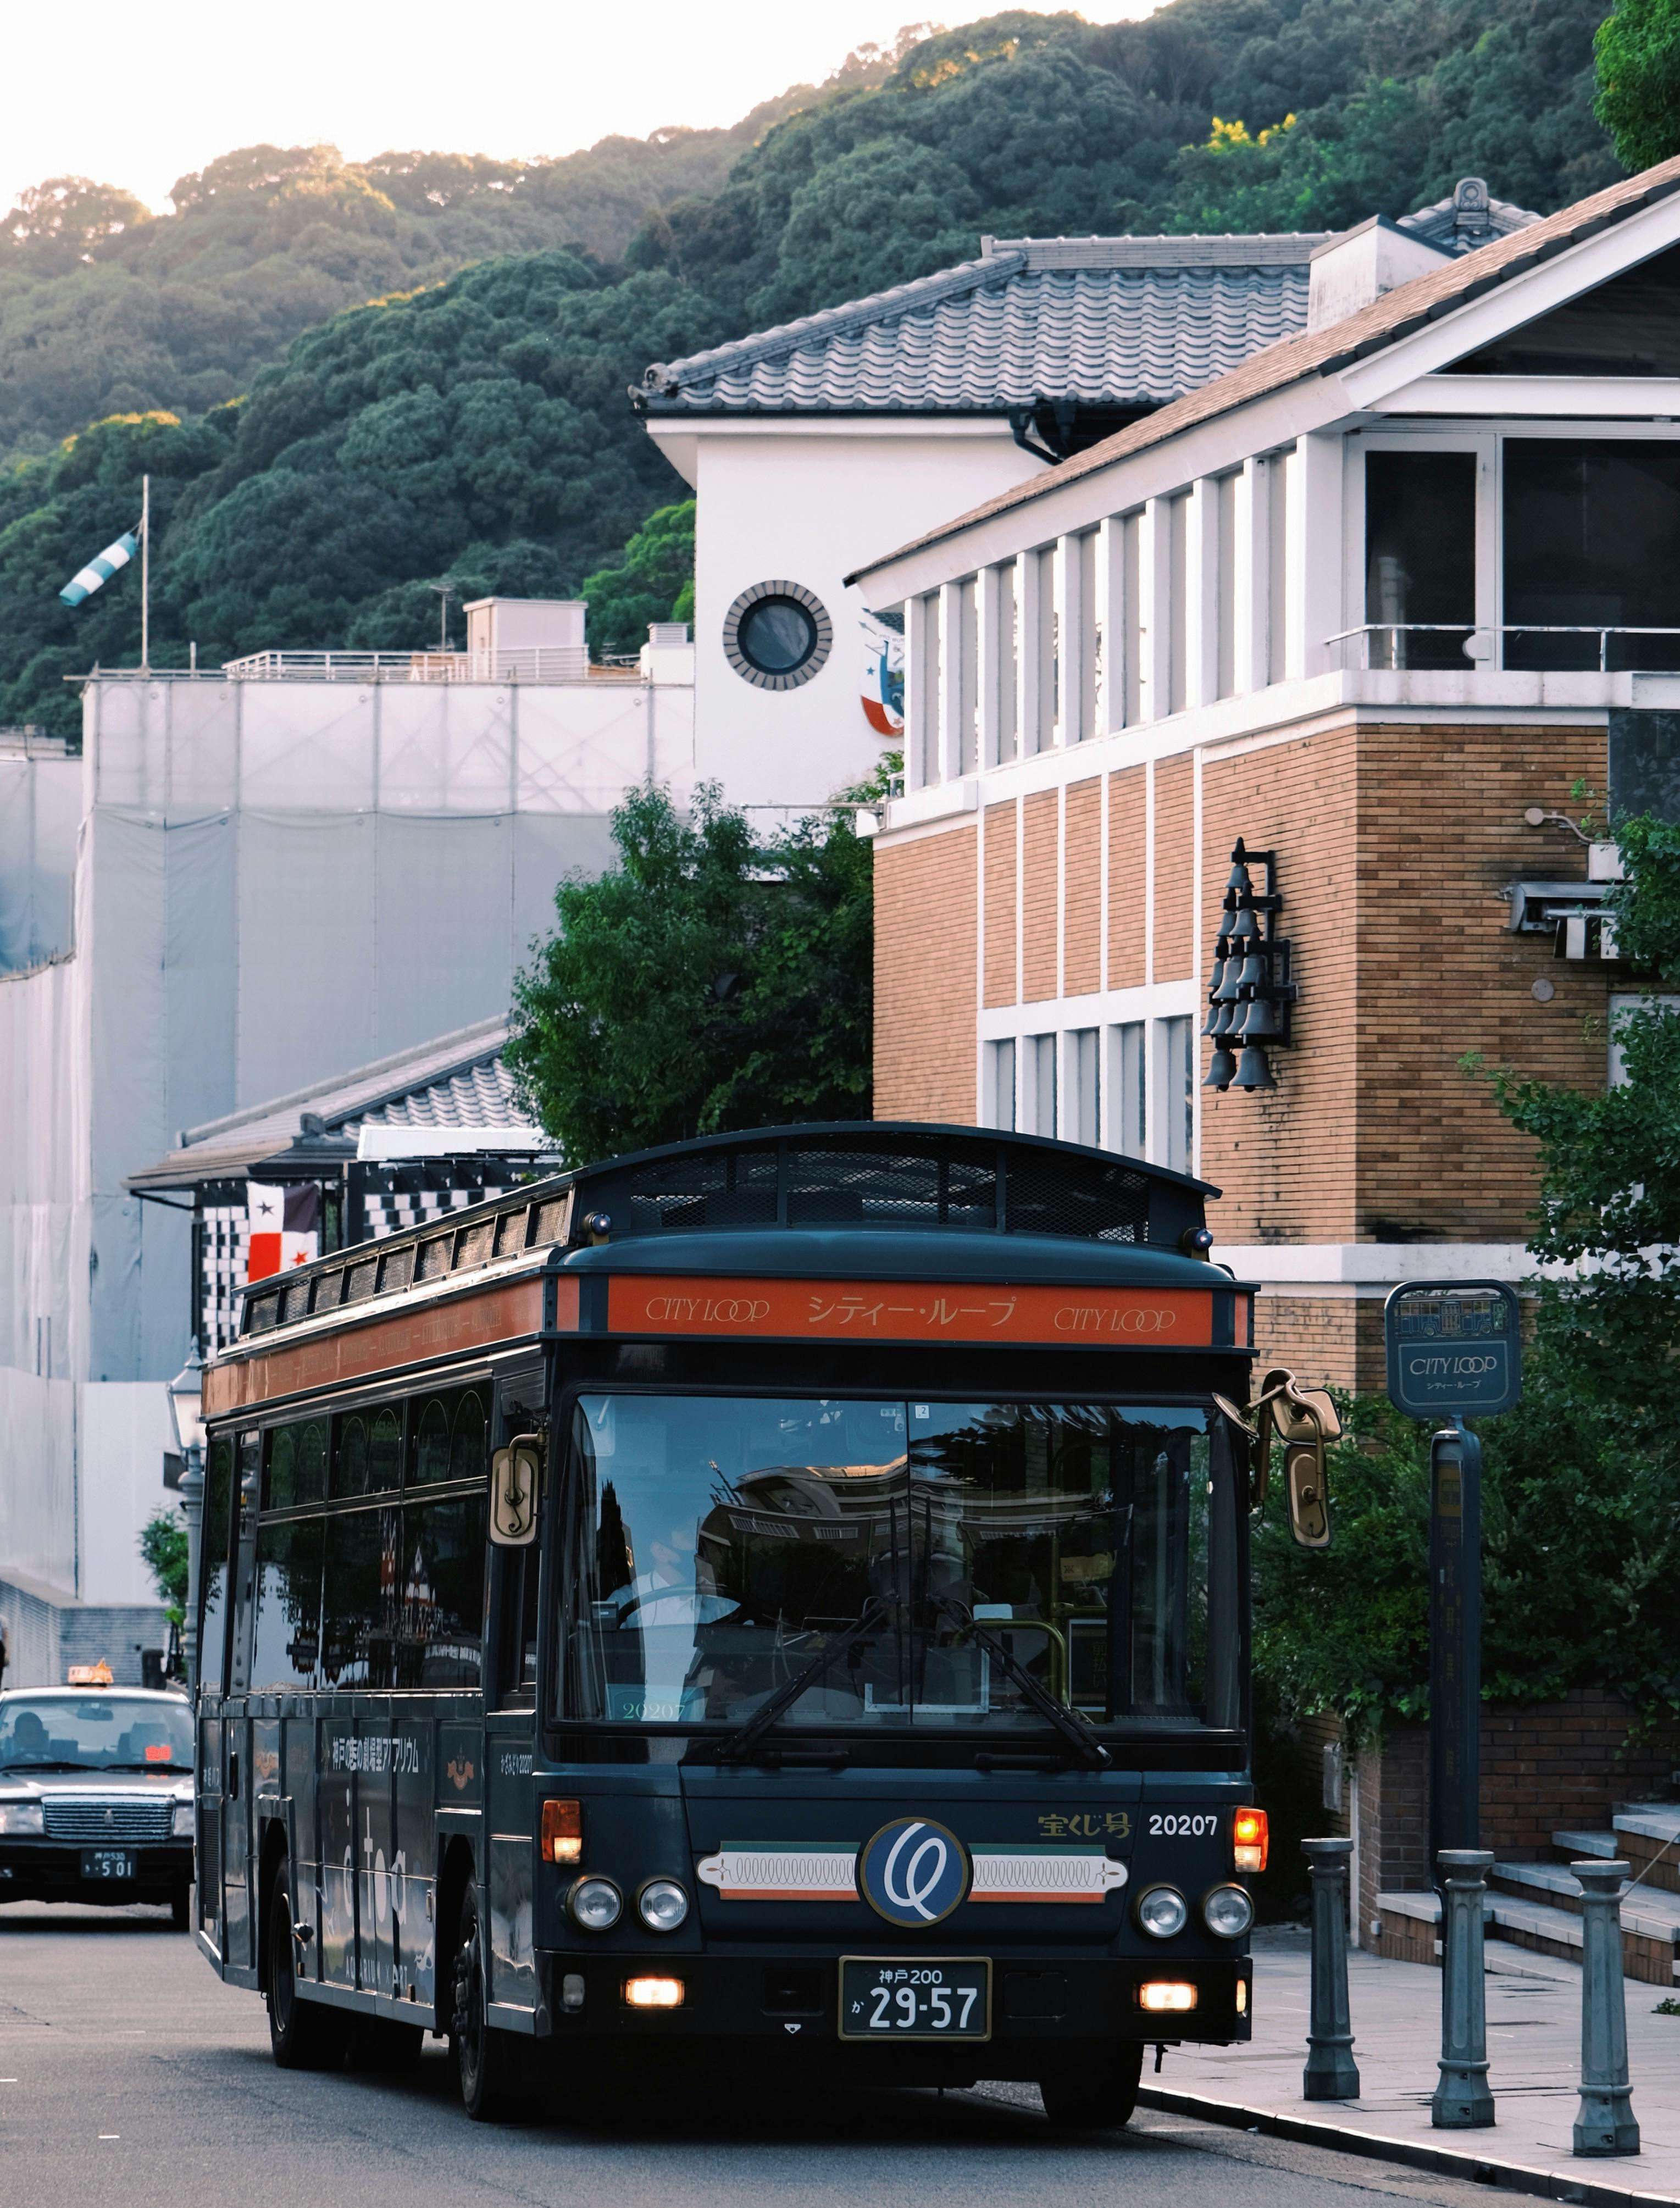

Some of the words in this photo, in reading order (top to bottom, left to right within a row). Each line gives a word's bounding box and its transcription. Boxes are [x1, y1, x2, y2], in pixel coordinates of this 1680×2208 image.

[646, 1297, 702, 1321] CITY
[703, 1299, 770, 1323] LOOP
[808, 1296, 1017, 1327] シティー・ループ
[1054, 1307, 1109, 1330] CITY
[1109, 1309, 1176, 1333] LOOP
[1409, 1357, 1452, 1375] CITY
[1452, 1356, 1497, 1374] LOOP
[1427, 1379, 1482, 1390] シティー・ループ
[623, 1702, 685, 1719] 20207
[1038, 1812, 1132, 1839] 宝くじ号
[1149, 1815, 1218, 1837] 20207
[346, 1955, 381, 1985] AQARIUM
[851, 2000, 864, 2013] か
[869, 1987, 978, 2028] 29-57
